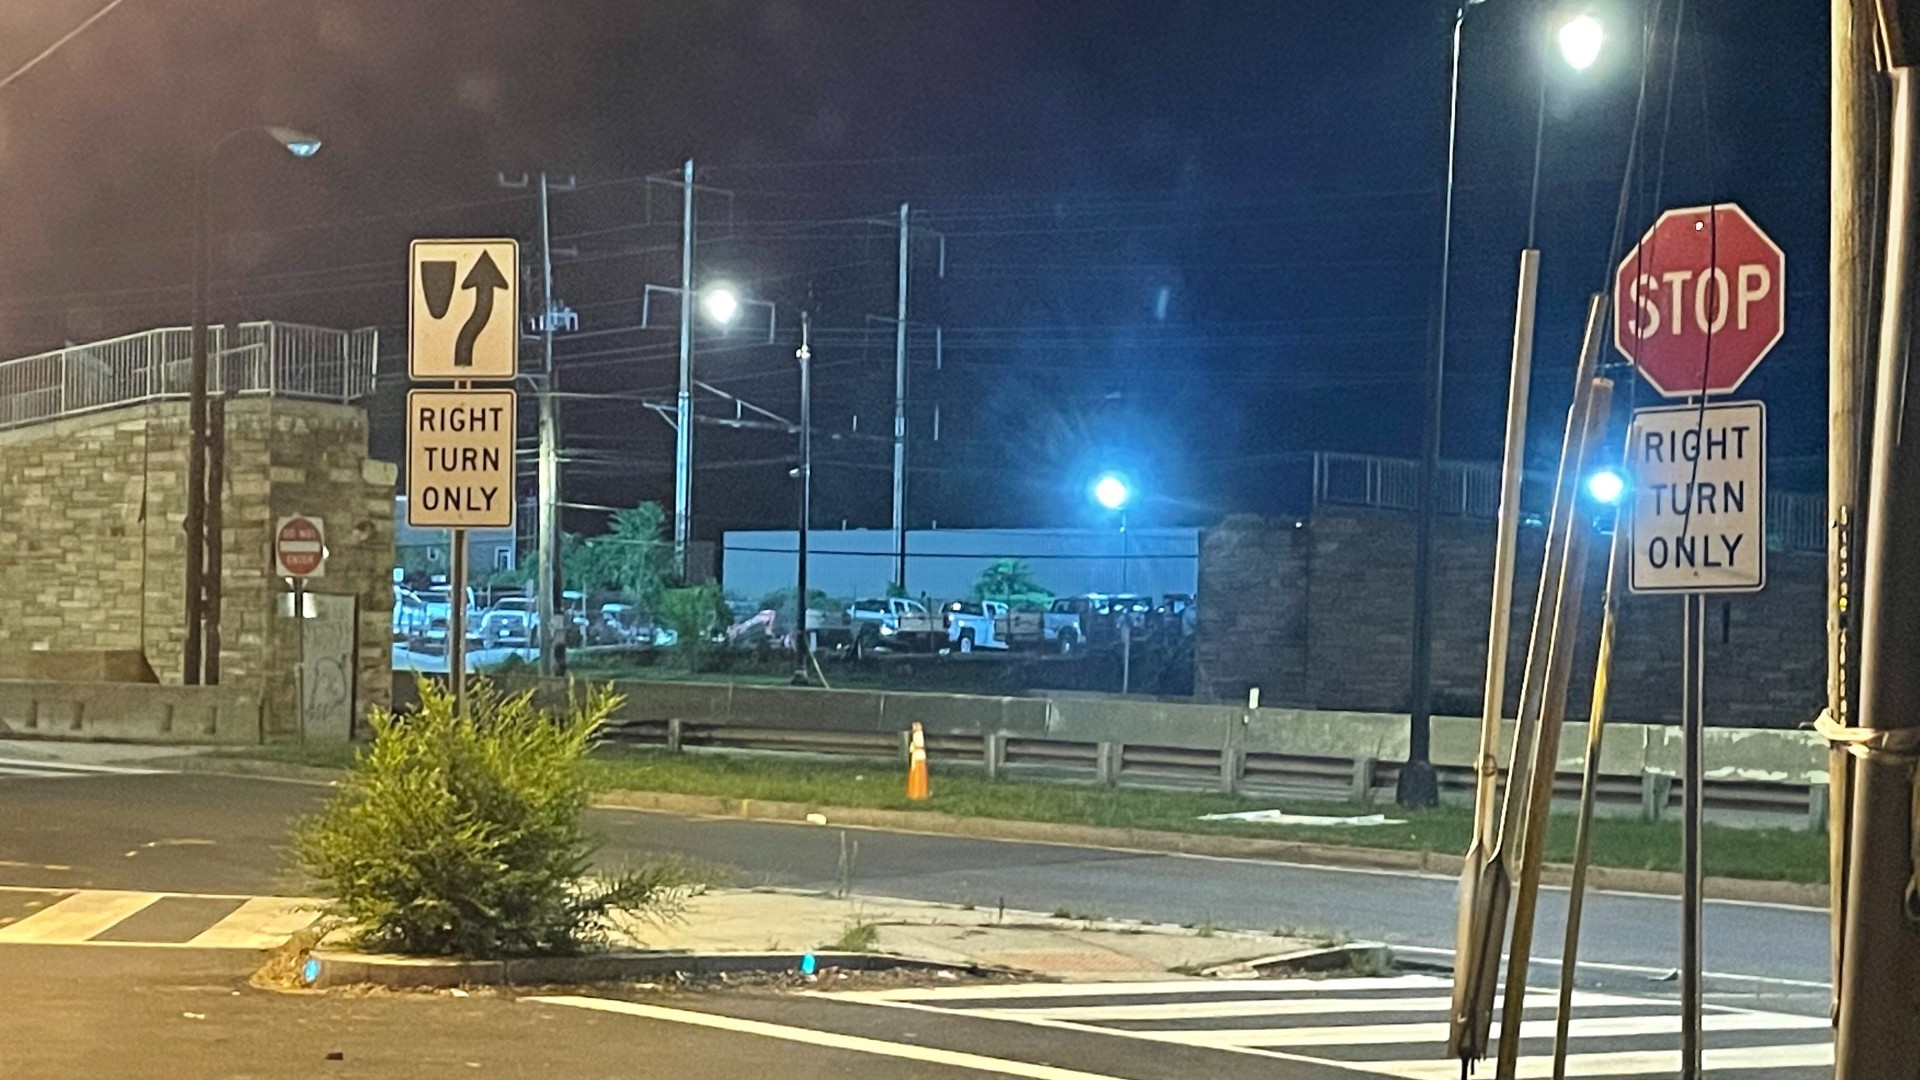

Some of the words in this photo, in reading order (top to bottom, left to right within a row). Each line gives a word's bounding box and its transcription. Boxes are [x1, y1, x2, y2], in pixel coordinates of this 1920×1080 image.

[1628, 263, 1771, 340] STOP
[420, 407, 503, 432] RIGHT
[424, 447, 499, 472] TURN
[1645, 426, 1750, 463] RIGHT
[422, 486, 498, 511] ONLY
[1651, 481, 1744, 515] TURN
[1648, 533, 1744, 569] ONLY
